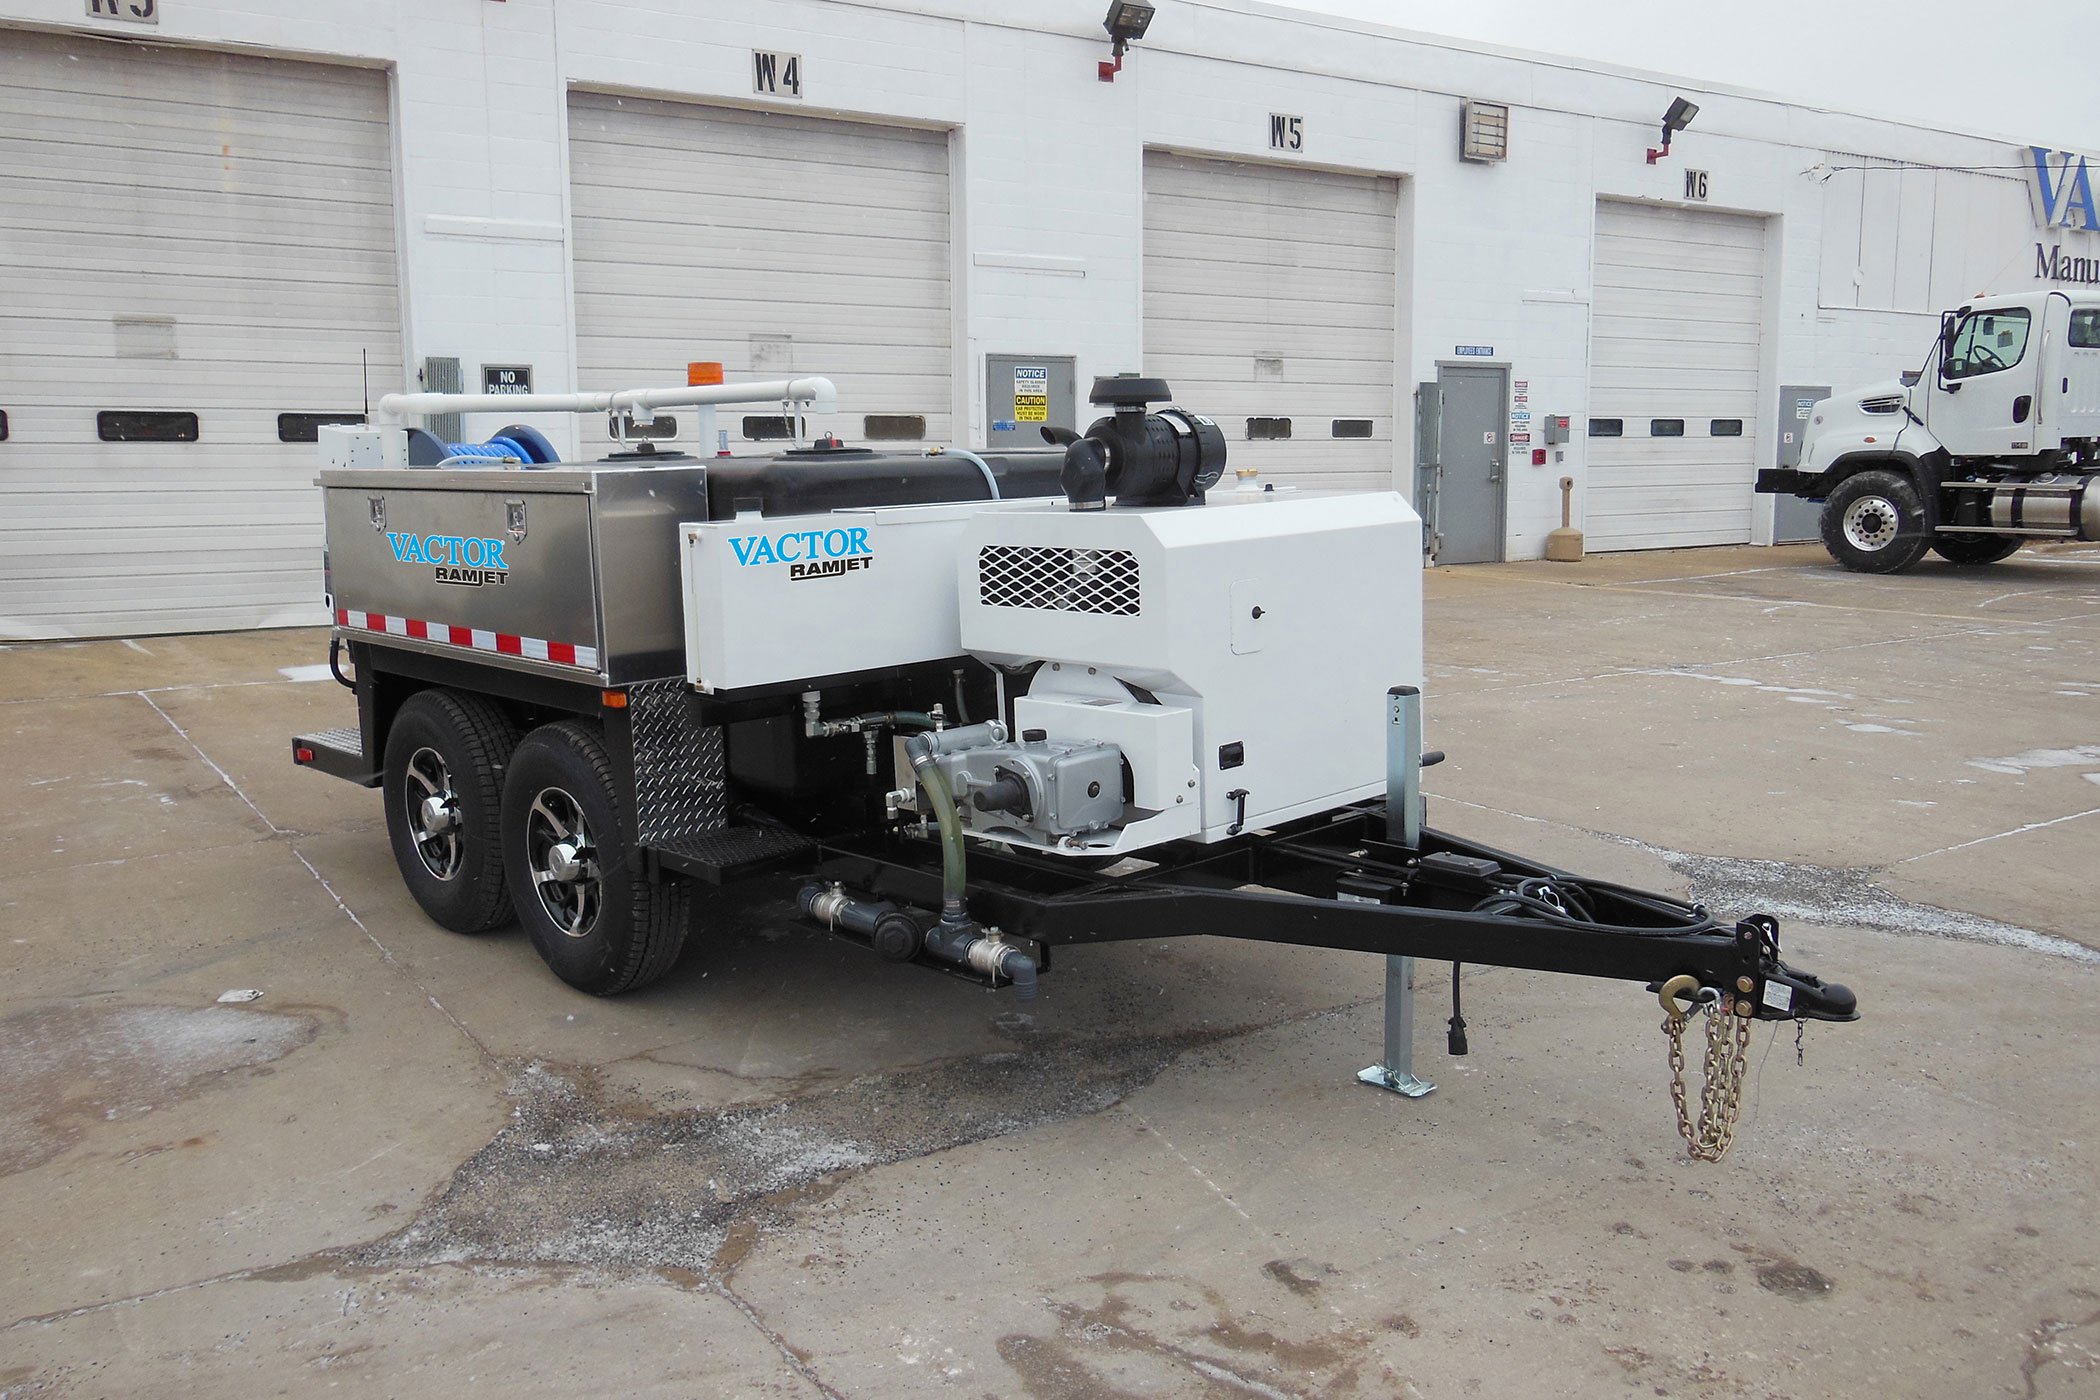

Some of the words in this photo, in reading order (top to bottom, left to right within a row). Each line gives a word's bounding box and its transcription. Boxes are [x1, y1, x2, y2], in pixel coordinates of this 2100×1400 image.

[755, 53, 799, 95] W4
[1271, 115, 1301, 149] W5
[1686, 171, 1706, 198] W6
[2029, 145, 2100, 231] VA
[2034, 243, 2100, 285] Manu
[500, 371, 516, 383] NO
[1016, 369, 1045, 378] NOTICE
[488, 384, 528, 395] PARKING
[1016, 396, 1045, 405] CAUTION
[387, 532, 509, 568] VACTOR
[727, 528, 873, 566] VACTOR
[435, 567, 509, 586] RAMJET
[790, 557, 873, 581] RAMJET
